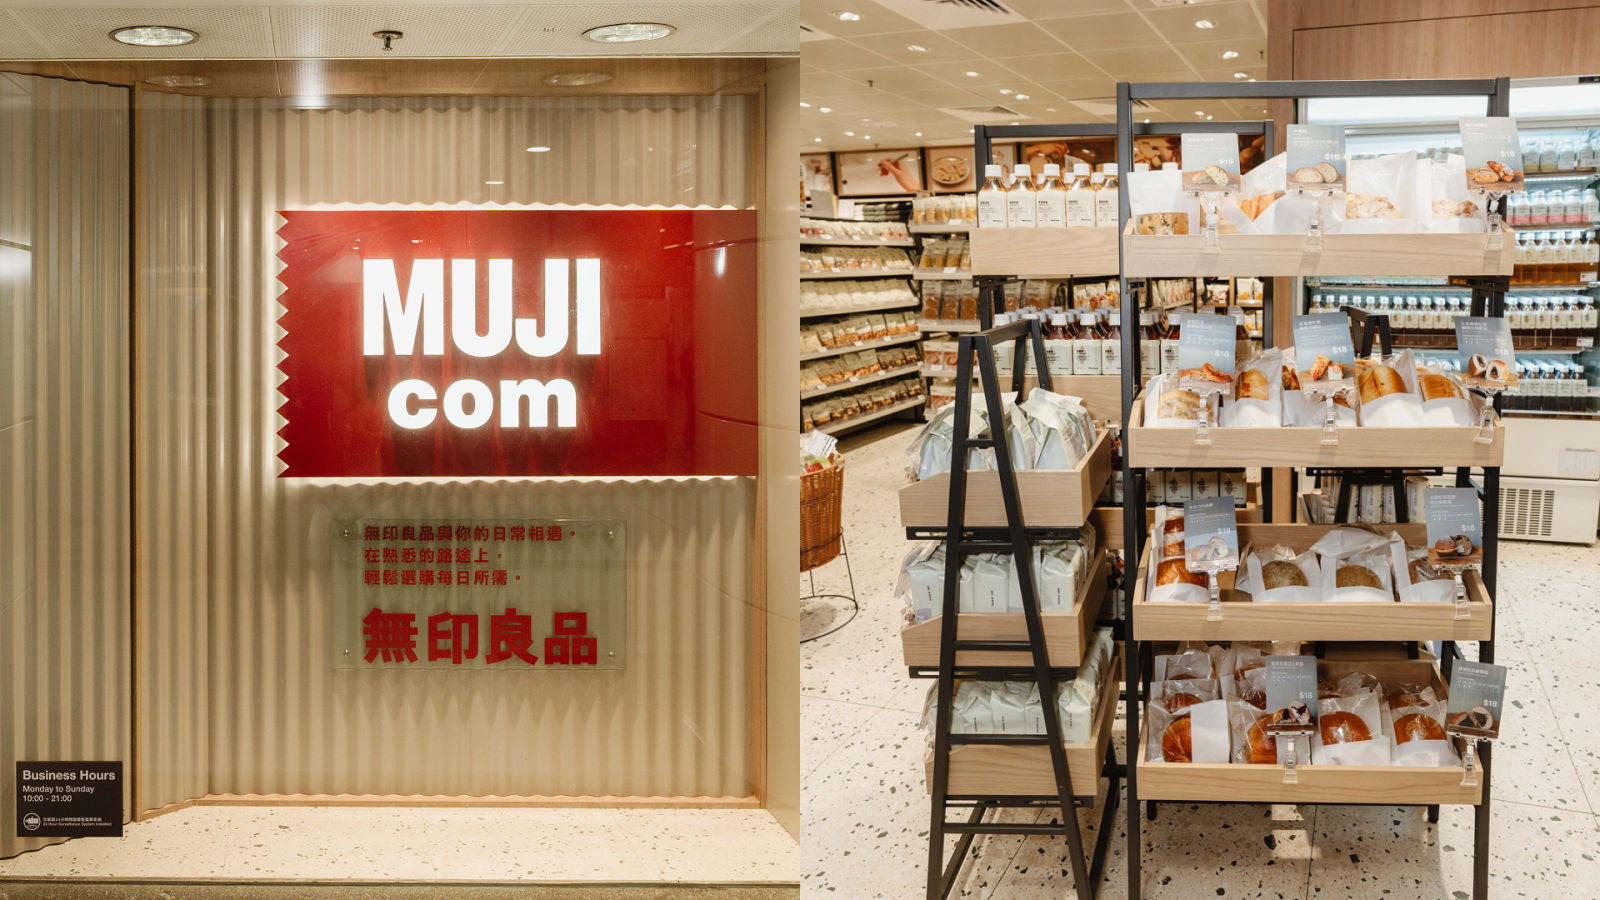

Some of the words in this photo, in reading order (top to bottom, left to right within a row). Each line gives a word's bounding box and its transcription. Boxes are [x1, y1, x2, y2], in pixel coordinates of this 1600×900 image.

[363, 258, 601, 357] MUJI
[388, 379, 577, 429] com
[364, 525, 576, 542] 無印良品與你的日常相遇。
[362, 607, 598, 665] 無印良品
[1299, 691, 1313, 699] $18
[1483, 699, 1498, 708] $18
[22, 770, 77, 780] Business
[79, 770, 116, 780] Hours
[22, 785, 54, 794] Monday
[65, 785, 95, 794] Sunday
[22, 794, 44, 802] 10:00
[51, 794, 72, 802] 21:00
